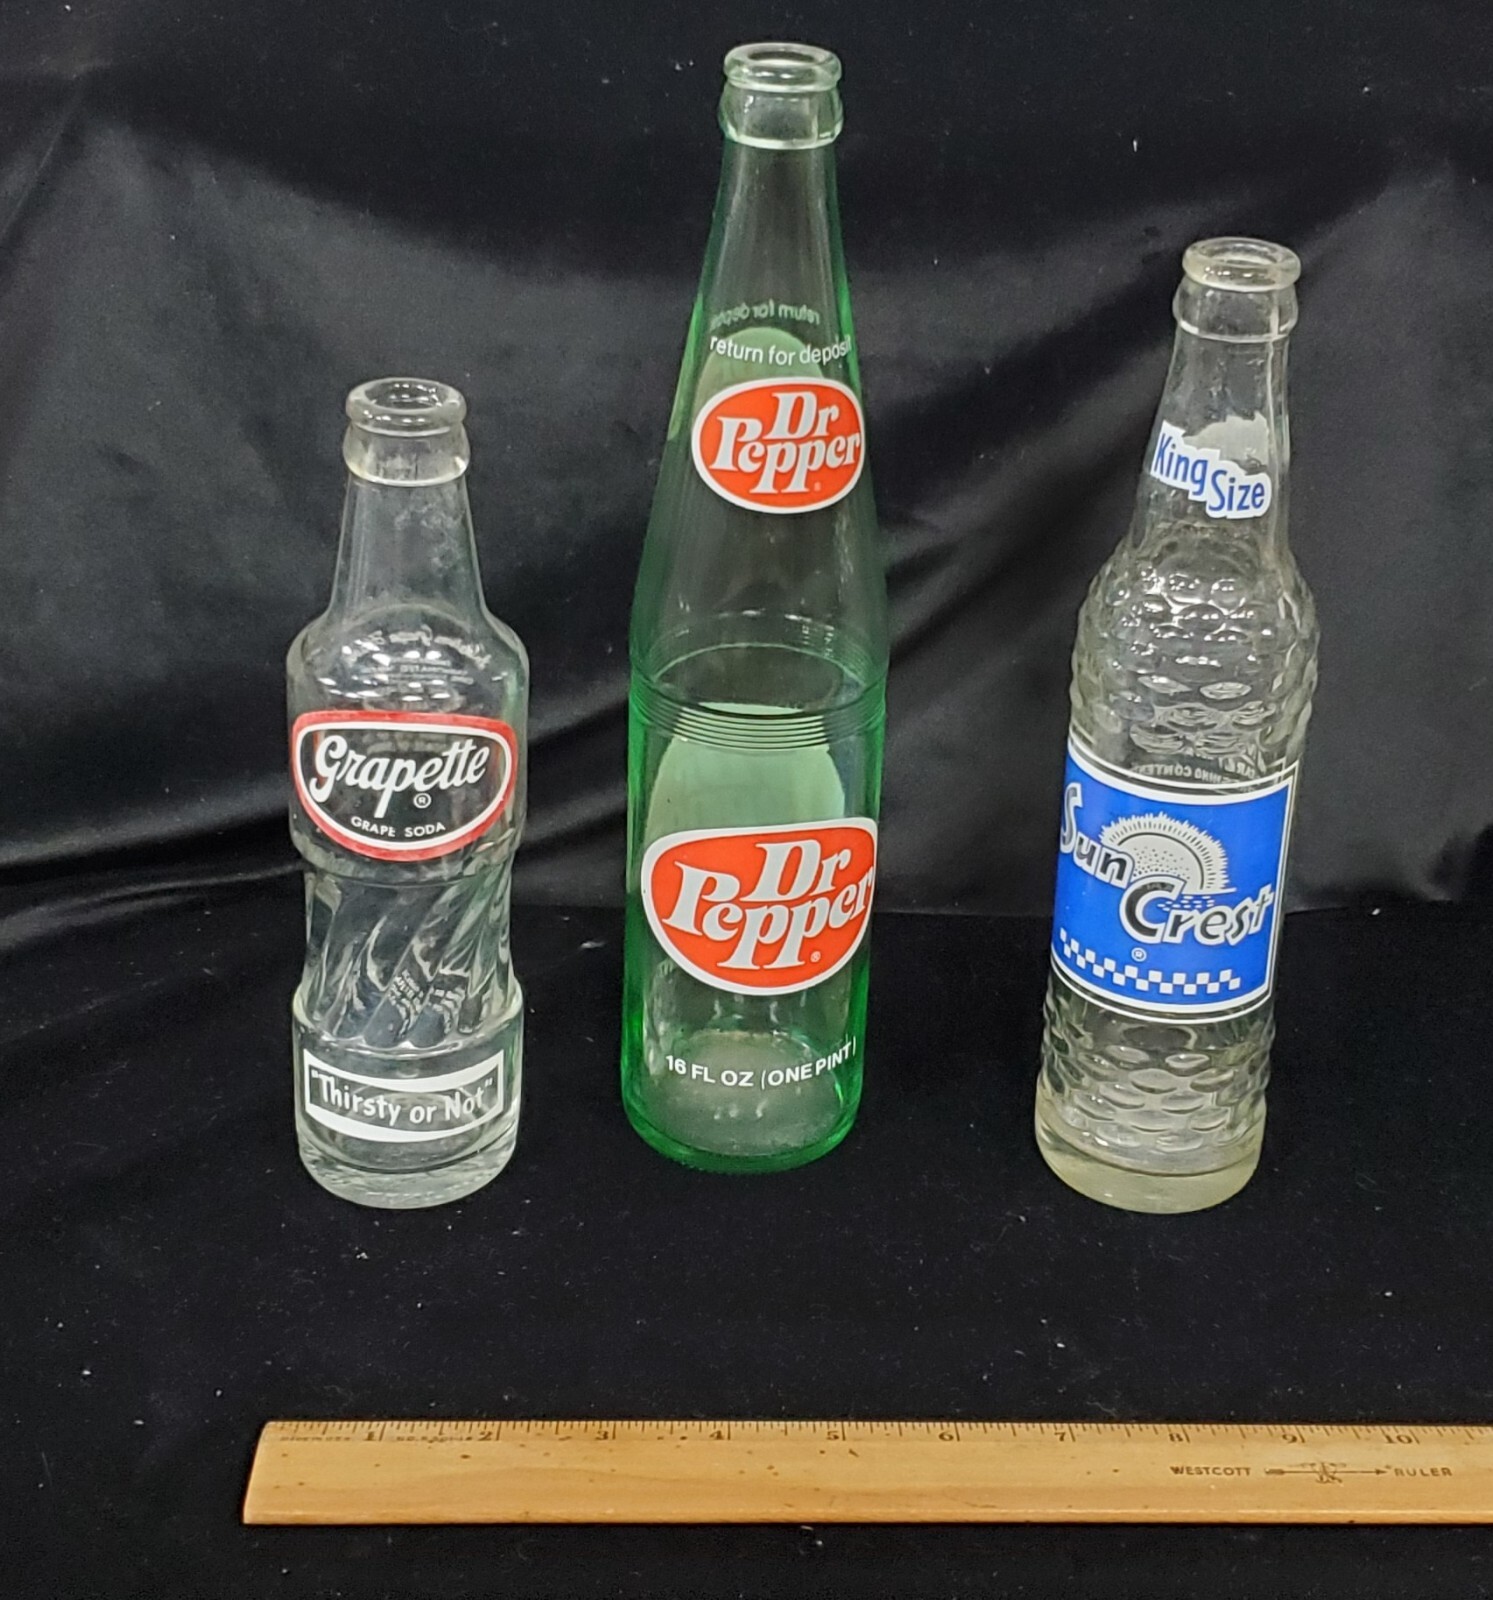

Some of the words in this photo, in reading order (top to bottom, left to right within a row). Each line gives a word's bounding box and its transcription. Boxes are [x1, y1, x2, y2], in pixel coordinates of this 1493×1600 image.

[709, 335, 764, 364] return
[768, 344, 796, 366] for
[762, 391, 840, 440] Dr
[709, 416, 862, 495] Pepper
[1153, 433, 1209, 496] King
[1208, 469, 1265, 512] Size
[309, 735, 490, 819] Grapette
[351, 815, 396, 838] GRAPE
[404, 821, 446, 838] SODA
[1060, 782, 1135, 890] Sun
[740, 839, 852, 902] Dr
[661, 861, 874, 970] Pepper
[1119, 873, 1276, 946] Crest
[665, 1055, 688, 1075] 16
[691, 1064, 716, 1084] FL
[720, 1070, 755, 1087] OZ
[760, 1062, 813, 1091] (ONE
[409, 1104, 438, 1124] or
[361, 1430, 376, 1442] 1
[478, 1430, 493, 1442] 2
[594, 1430, 610, 1442] 3
[708, 1430, 724, 1441] 4
[826, 1430, 840, 1441] 5
[938, 1431, 954, 1442] 6
[1053, 1431, 1067, 1442] 7
[1168, 1432, 1184, 1443] 8
[1281, 1432, 1298, 1445] 9
[1384, 1432, 1413, 1445] 10
[1169, 1465, 1252, 1477] WESTCOTT
[1393, 1466, 1453, 1478] RULER
